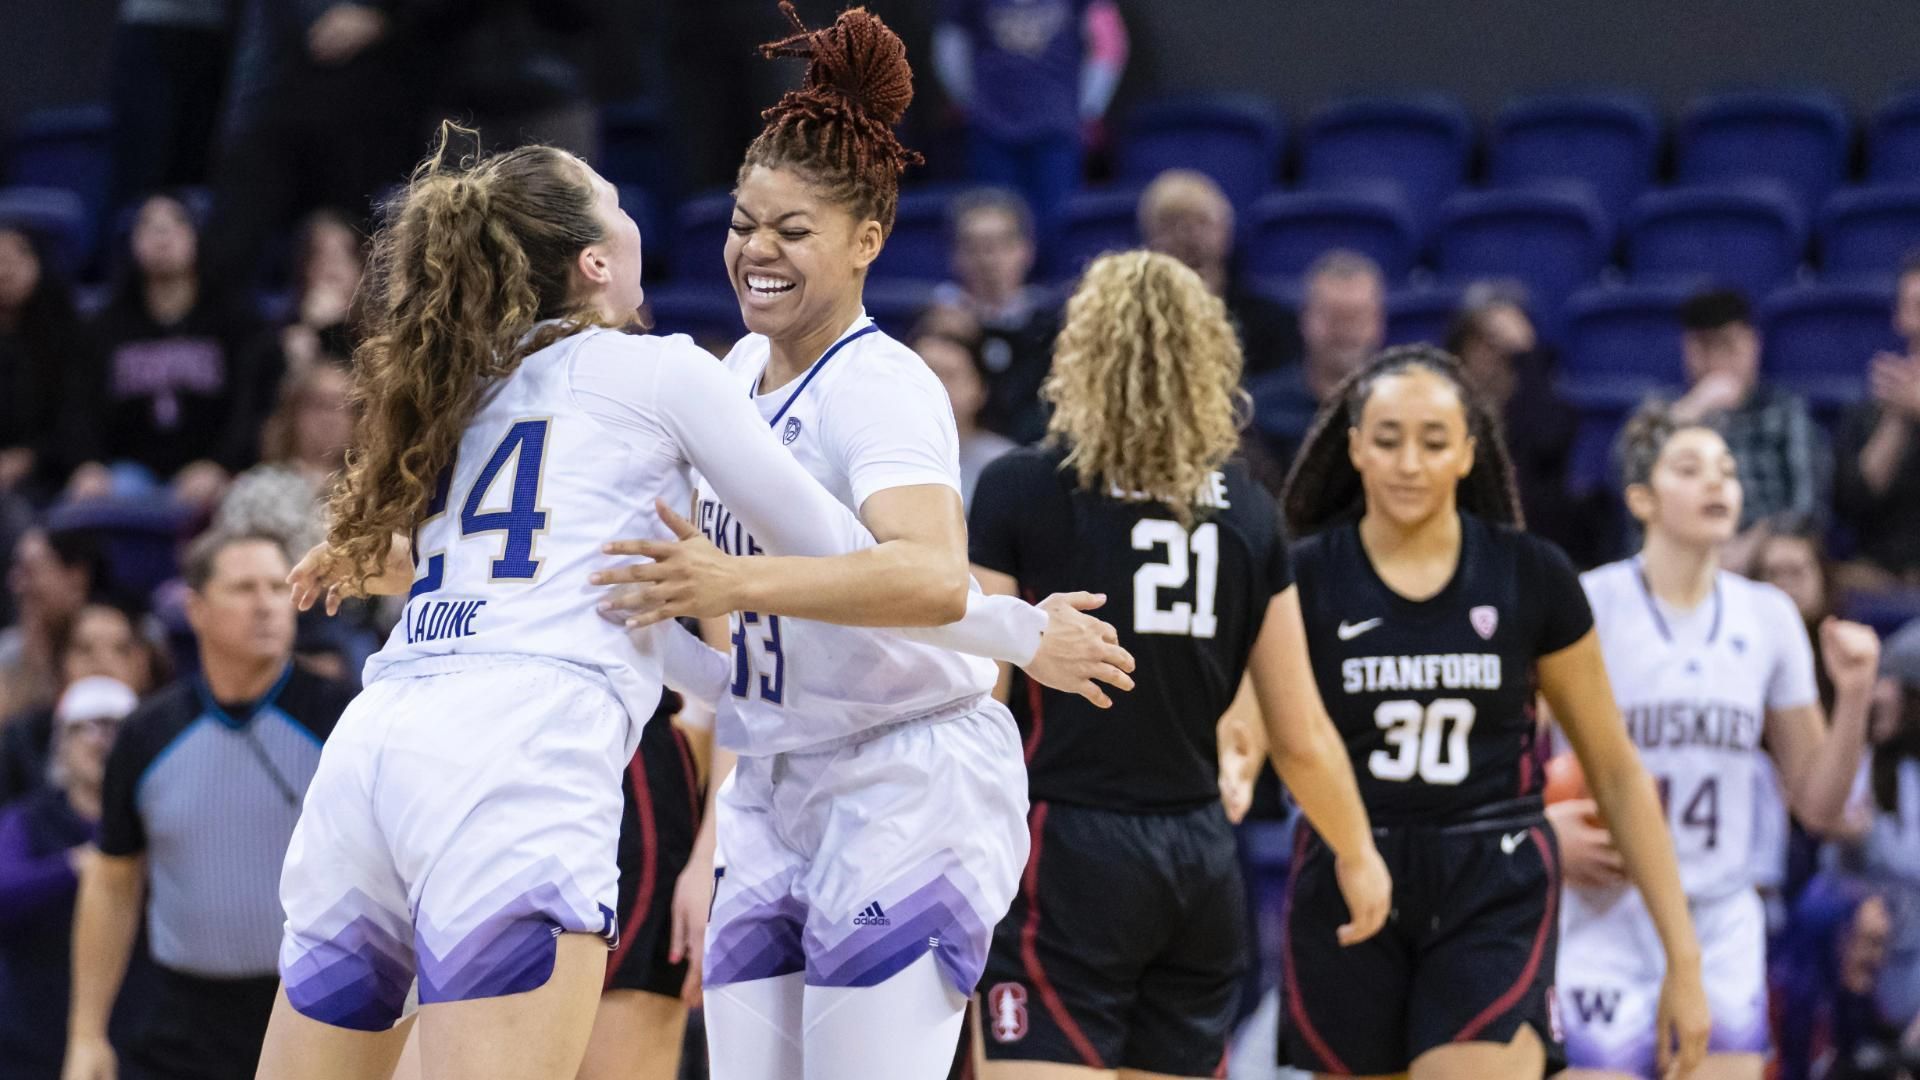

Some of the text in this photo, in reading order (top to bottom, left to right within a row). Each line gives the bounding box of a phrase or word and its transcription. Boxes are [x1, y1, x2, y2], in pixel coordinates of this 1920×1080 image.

[1131, 518, 1219, 638] 21
[407, 600, 487, 644] LADINE
[1342, 653, 1501, 693] STANFORD
[1368, 698, 1476, 785] 30
[853, 916, 891, 926] adidas
[1571, 987, 1622, 1023] W
